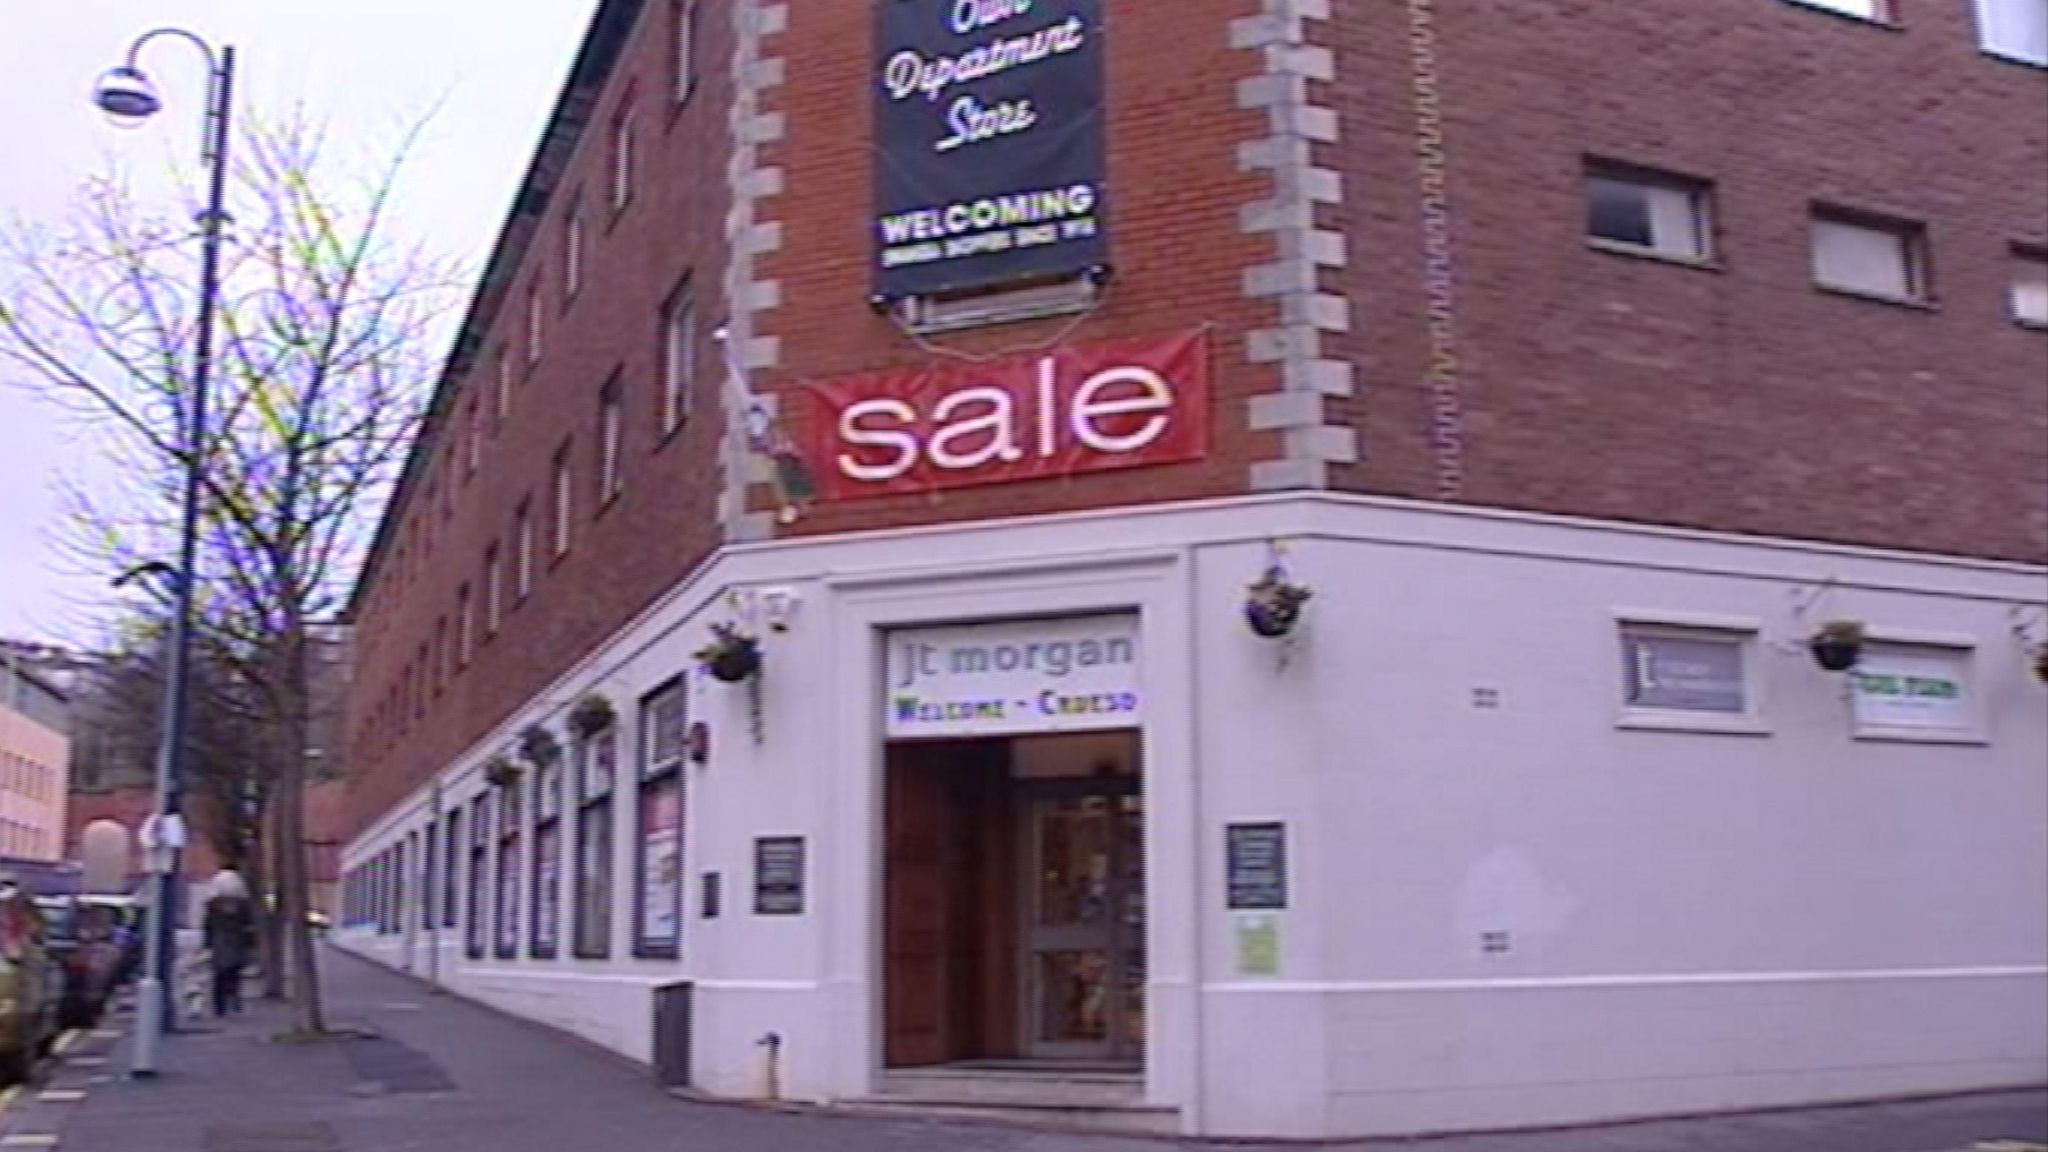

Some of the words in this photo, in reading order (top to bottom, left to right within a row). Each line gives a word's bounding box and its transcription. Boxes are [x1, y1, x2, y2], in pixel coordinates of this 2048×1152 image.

[885, 15, 1085, 100] Department
[935, 96, 1038, 151] Store
[880, 184, 1096, 244] WELCOMING
[838, 356, 1174, 480] sale
[951, 636, 1133, 677] morgan
